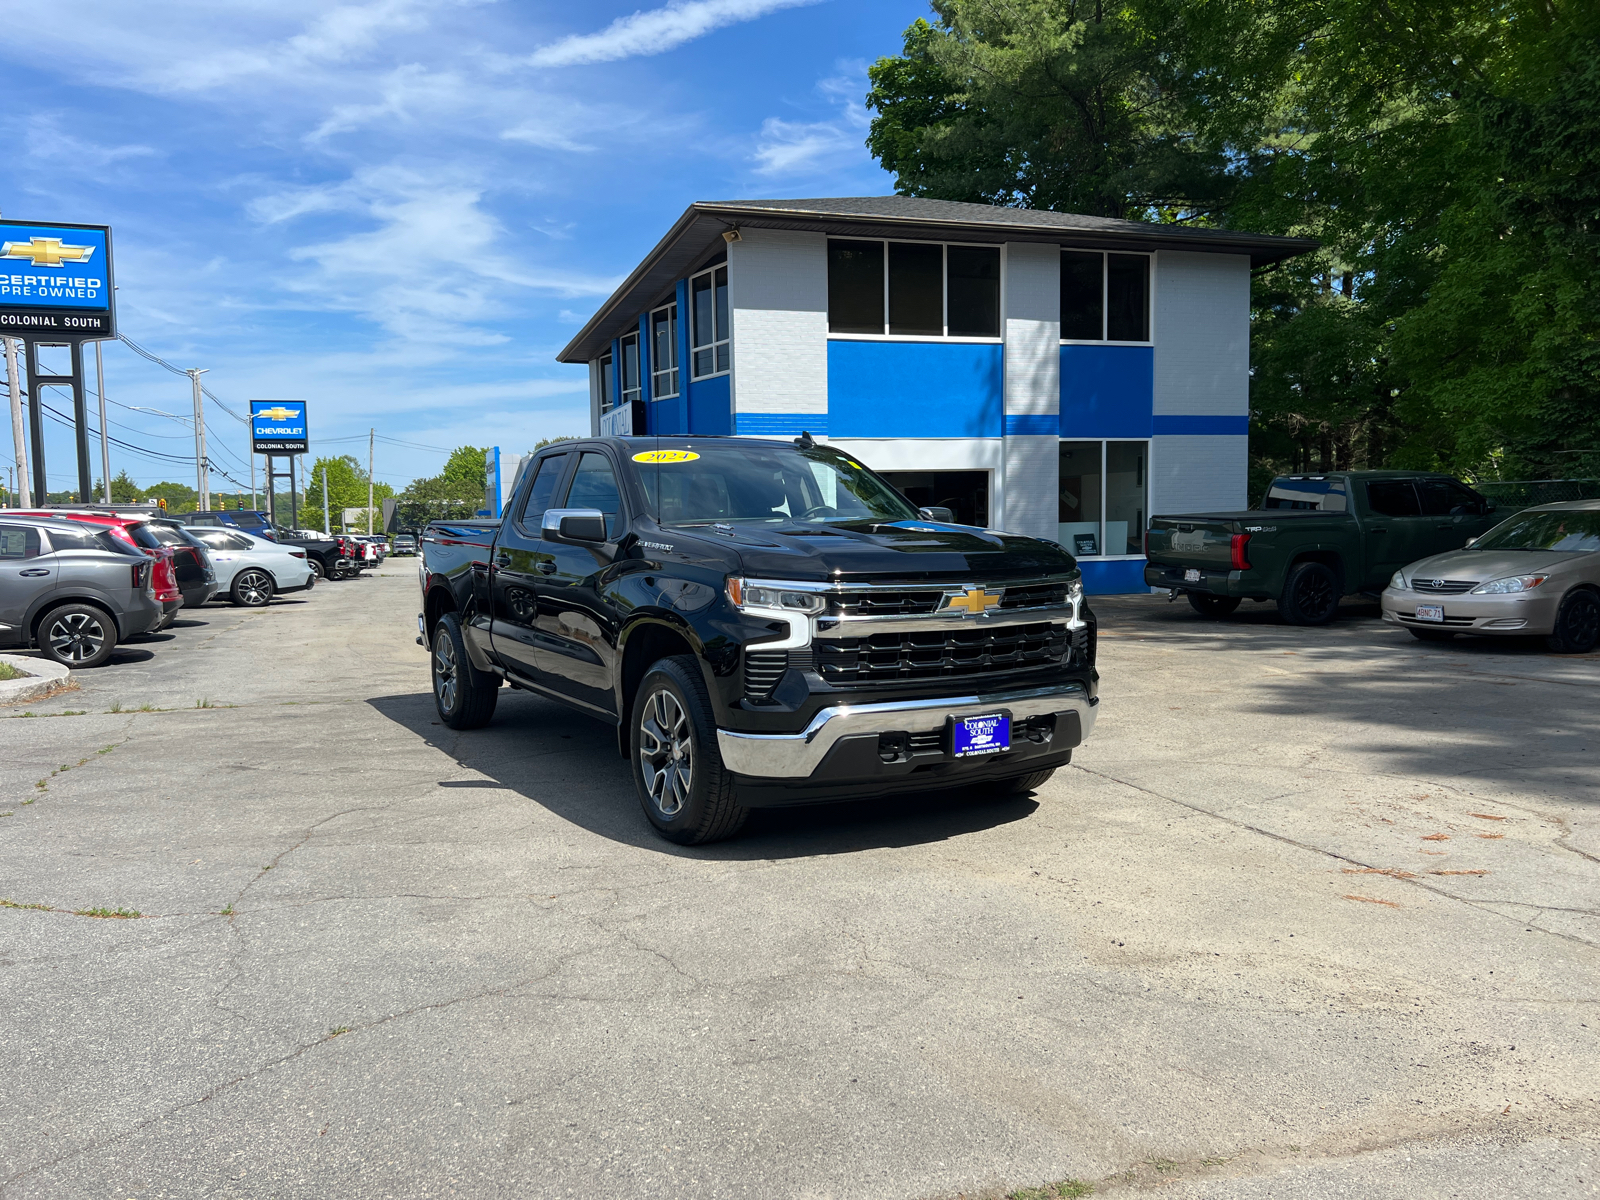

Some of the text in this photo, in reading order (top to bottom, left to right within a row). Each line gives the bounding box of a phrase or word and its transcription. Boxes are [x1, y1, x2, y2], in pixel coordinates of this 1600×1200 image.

[0, 275, 101, 288] CERTIFIED
[2, 286, 97, 298] PRE-OWNED
[1, 315, 101, 327] COLONIAL SOUTH
[256, 427, 303, 435] CHEVROLET
[646, 452, 690, 461] 2024
[965, 720, 998, 730] COLONIAL
[970, 727, 993, 736] SOUTH
